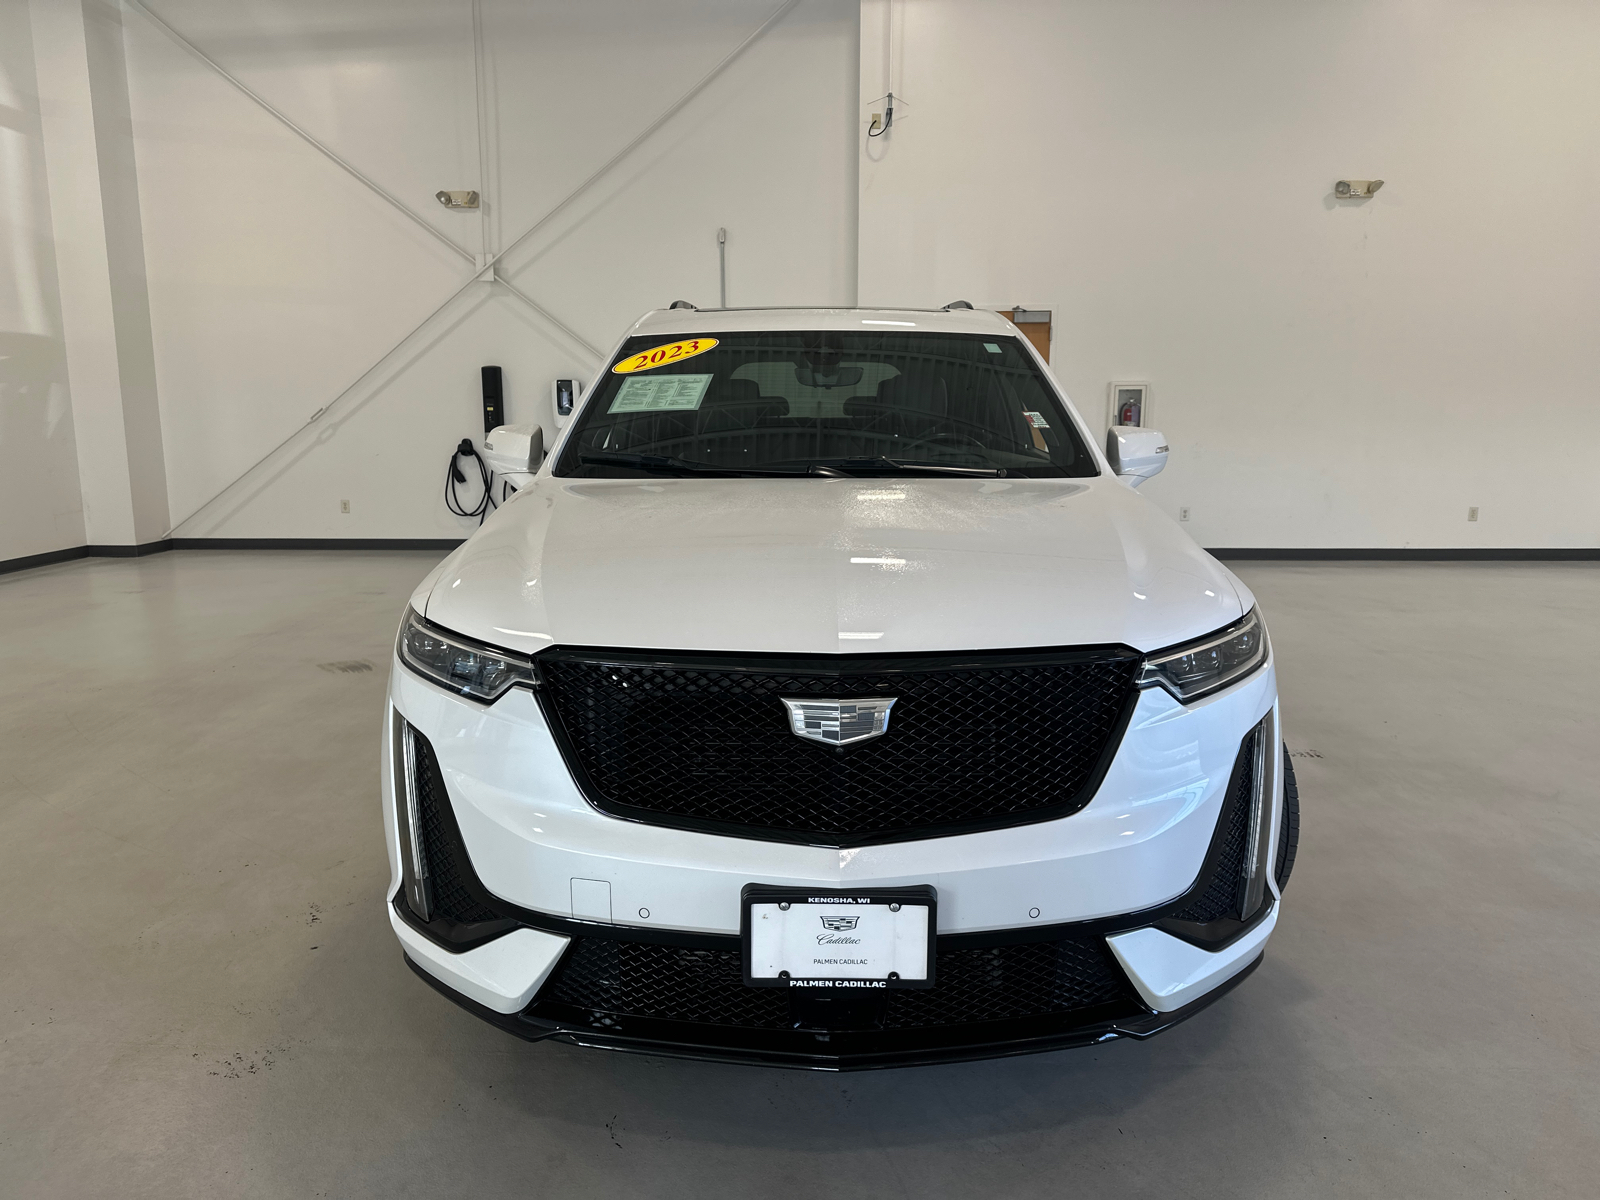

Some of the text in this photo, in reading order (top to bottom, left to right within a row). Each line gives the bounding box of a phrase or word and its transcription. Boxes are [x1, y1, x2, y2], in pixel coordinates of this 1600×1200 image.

[633, 340, 699, 370] 2023
[816, 933, 861, 946] Cadillac
[789, 980, 887, 988] PALMEN CADILLAC
